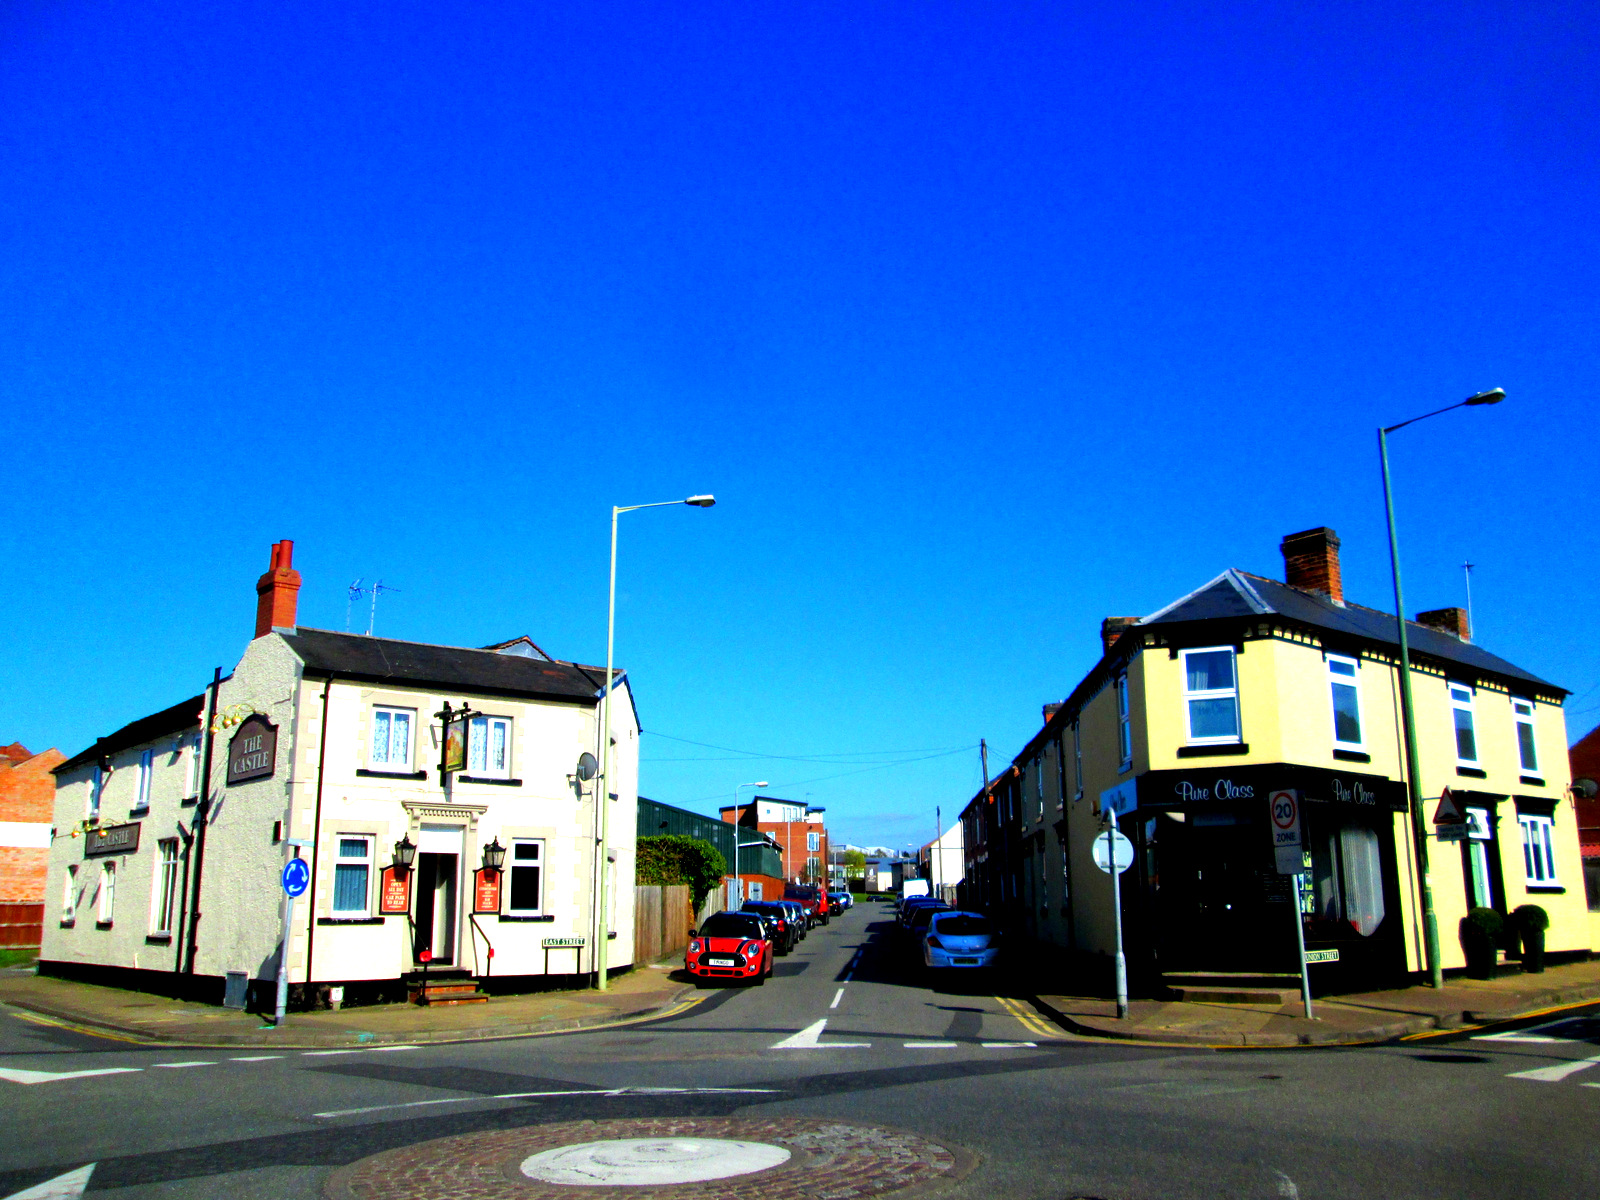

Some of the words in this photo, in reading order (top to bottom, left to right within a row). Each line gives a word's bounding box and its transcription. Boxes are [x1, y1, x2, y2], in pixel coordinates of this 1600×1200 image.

[243, 734, 262, 754] THE
[233, 751, 269, 774] CASTLE
[1175, 781, 1210, 801] Pure
[1214, 779, 1255, 800] Class
[1331, 778, 1351, 803] Pure
[1353, 781, 1376, 806] Class
[1275, 803, 1292, 819] 20
[1276, 832, 1296, 843] ZONE
[1305, 952, 1320, 961] UNION
[1321, 951, 1338, 960] STREET
